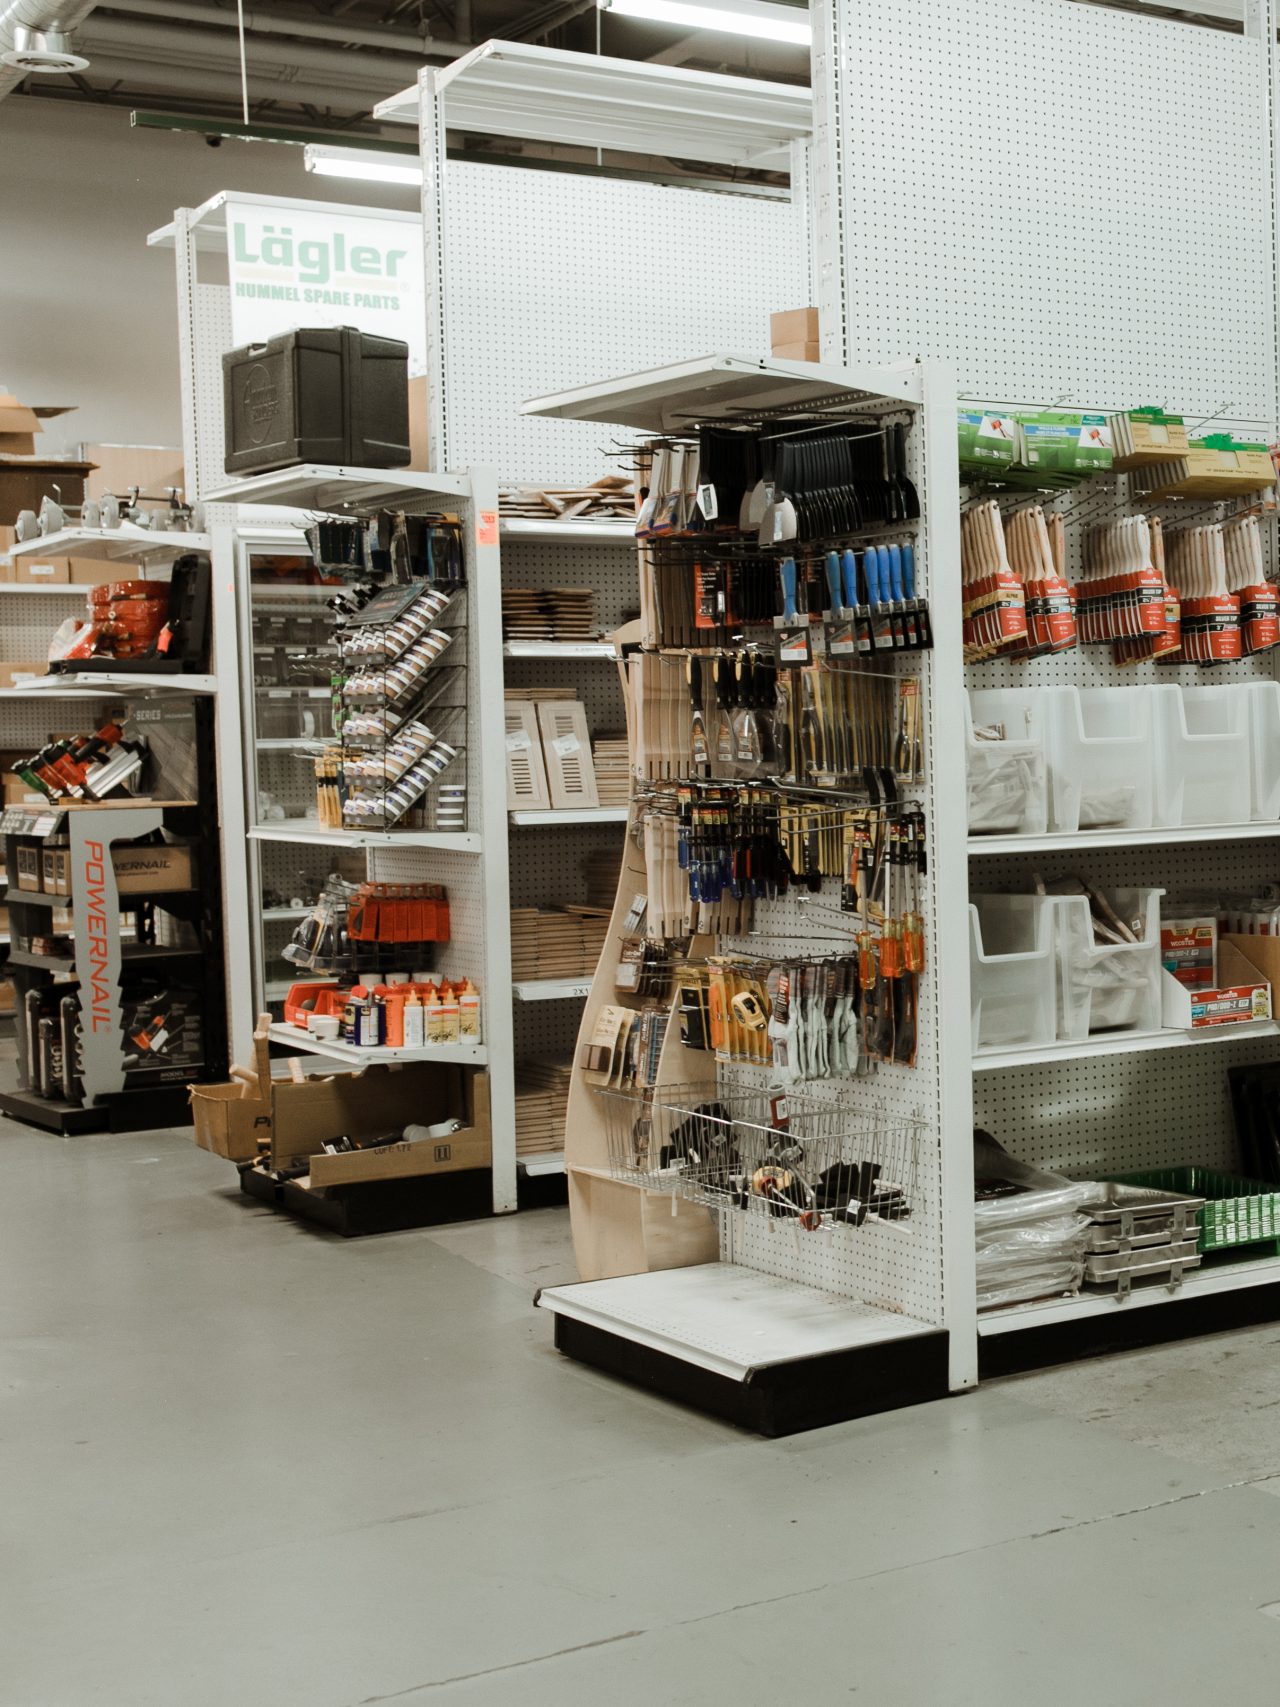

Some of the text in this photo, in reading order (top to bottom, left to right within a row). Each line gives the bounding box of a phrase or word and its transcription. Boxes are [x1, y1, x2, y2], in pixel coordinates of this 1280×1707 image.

[234, 222, 408, 284] Lägler
[235, 282, 401, 311] HUMMEL SPARE PARTS
[85, 840, 111, 1033] POWERNAIL
[574, 988, 589, 996] 2X1
[1217, 992, 1238, 1000] WOOSTER
